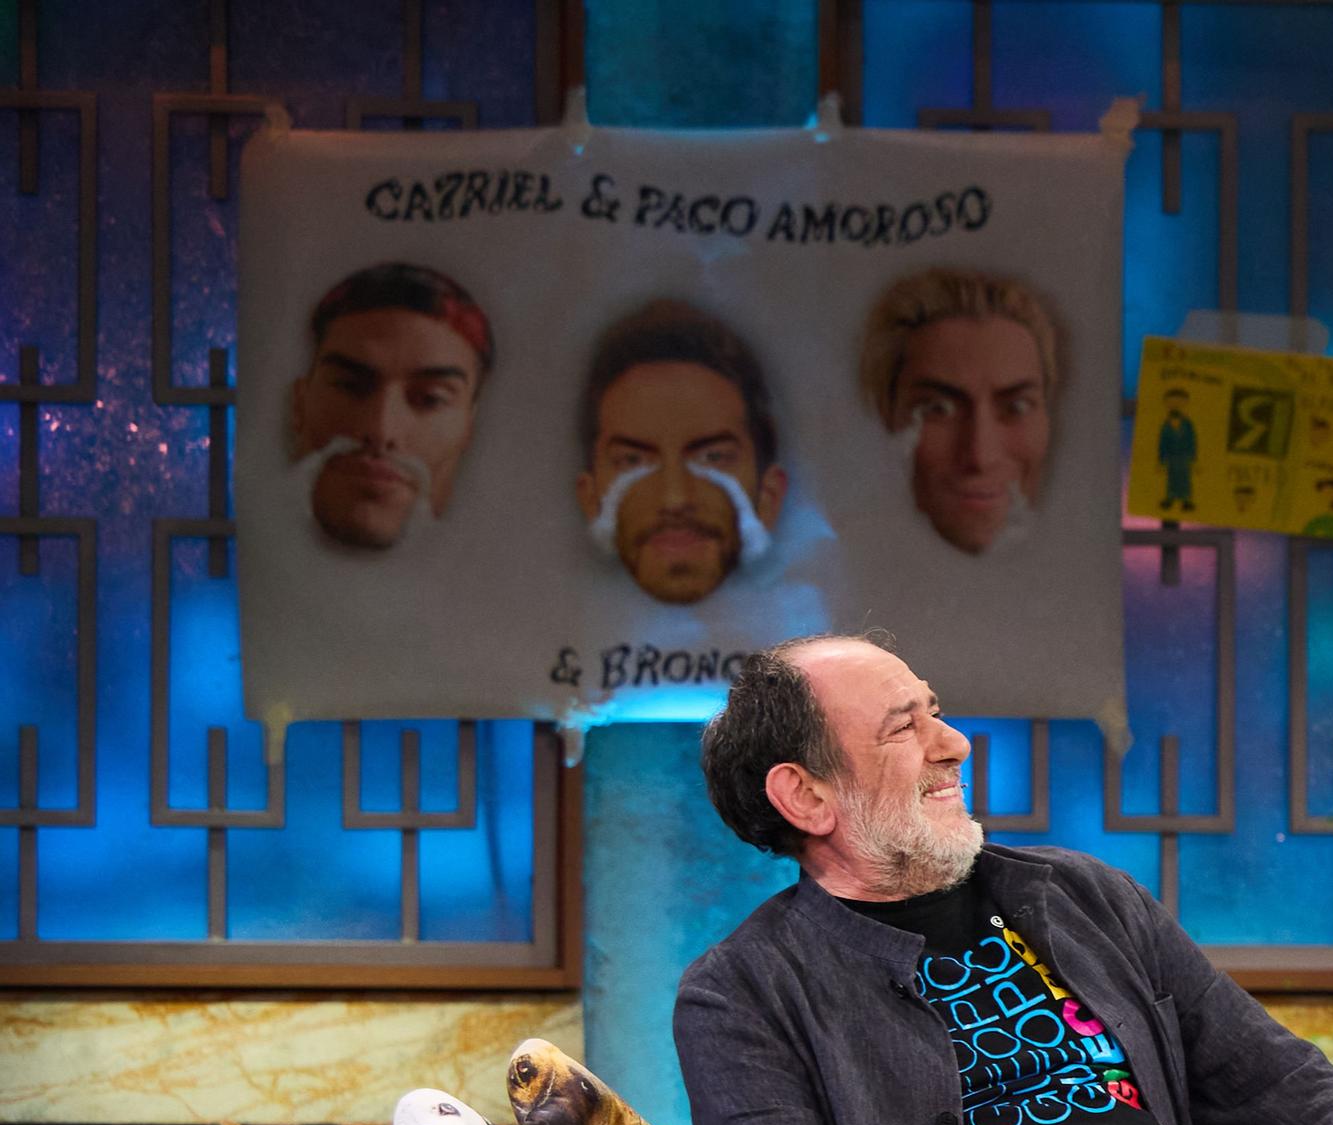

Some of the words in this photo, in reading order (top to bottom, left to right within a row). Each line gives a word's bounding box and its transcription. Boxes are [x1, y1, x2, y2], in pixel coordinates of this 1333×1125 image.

[581, 172, 620, 223] &
[634, 183, 761, 237] PACO
[766, 185, 994, 248] AMOROSO
